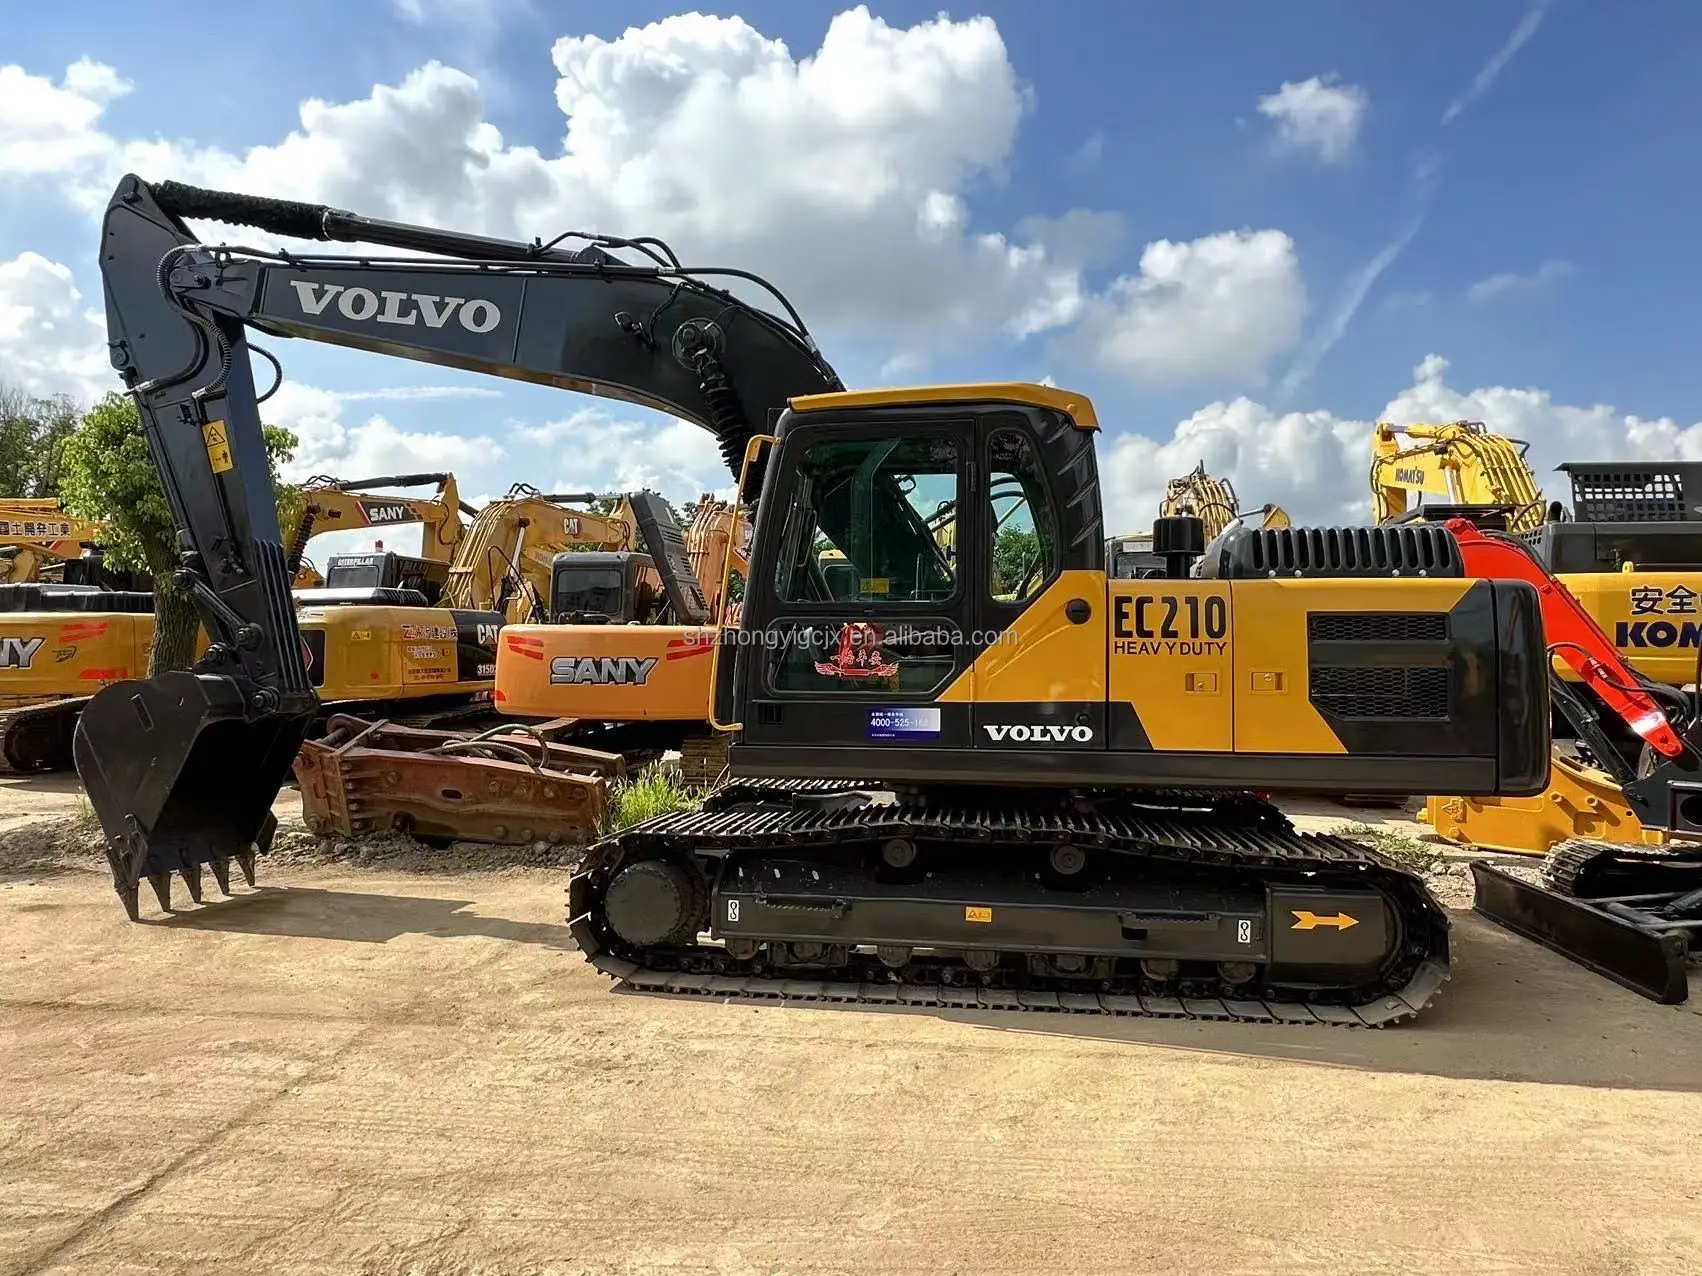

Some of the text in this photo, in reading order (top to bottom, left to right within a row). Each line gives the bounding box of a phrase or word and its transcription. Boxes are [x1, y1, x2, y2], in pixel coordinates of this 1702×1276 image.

[290, 280, 501, 333] VOLVO
[369, 506, 404, 521] SANY
[563, 517, 579, 534] CAT
[1631, 585, 1702, 615] 安全
[1114, 595, 1226, 639] EC210
[477, 624, 499, 645] CAT
[1114, 641, 1228, 656] HEAVY DUTY
[551, 656, 658, 685] SANY
[983, 725, 1093, 741] VOLVO
